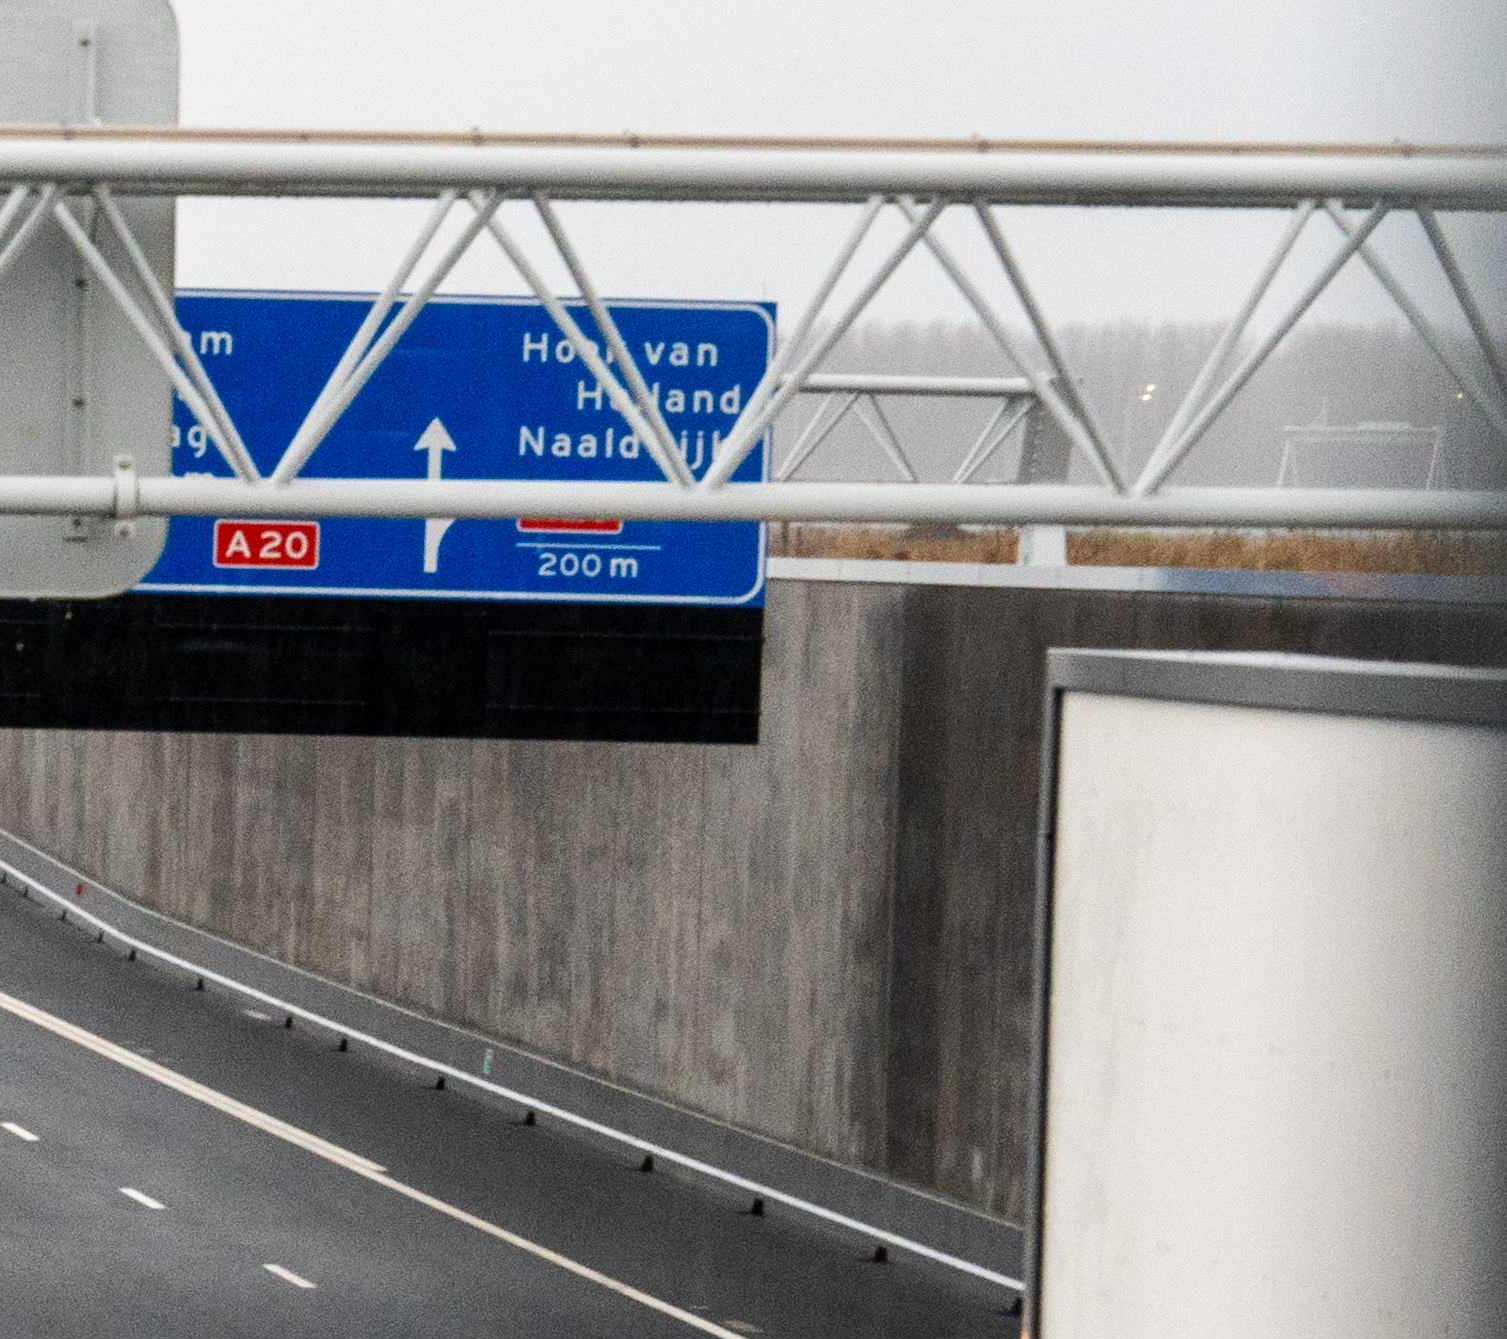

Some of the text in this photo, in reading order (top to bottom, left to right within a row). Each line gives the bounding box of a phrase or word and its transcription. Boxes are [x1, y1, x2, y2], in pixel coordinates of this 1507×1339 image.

[644, 341, 718, 367] van
[537, 553, 639, 579] 200 m
